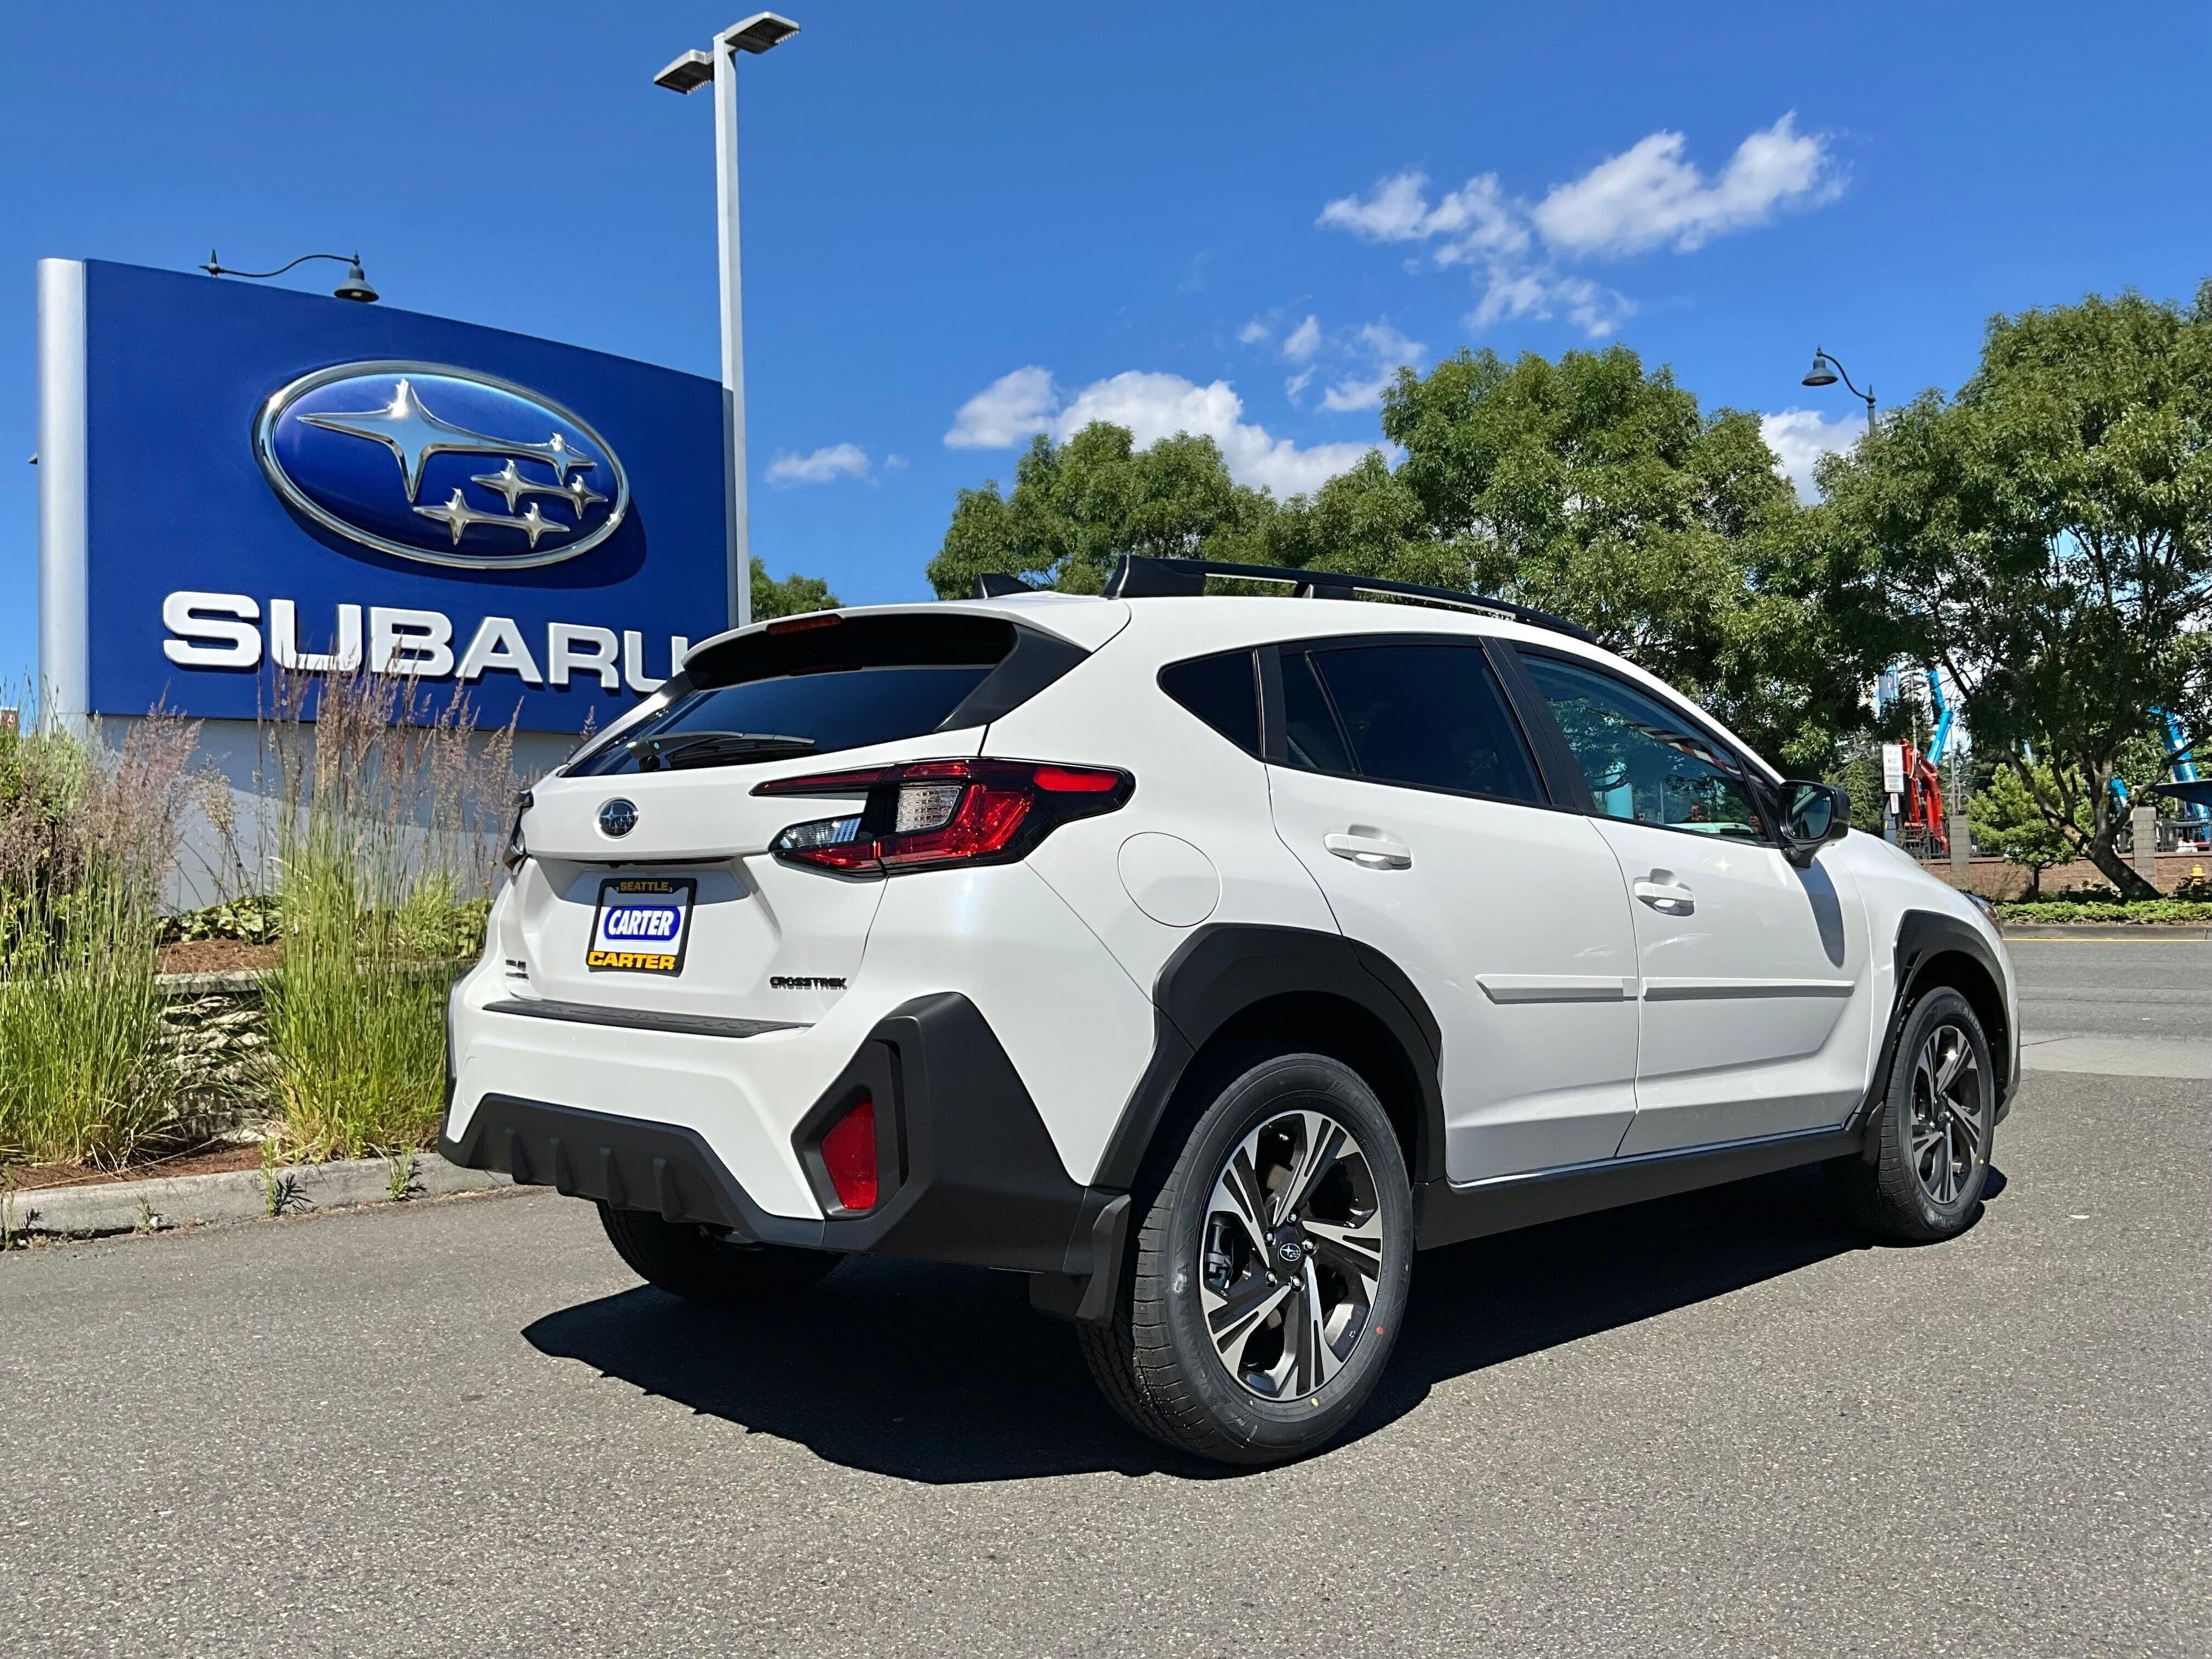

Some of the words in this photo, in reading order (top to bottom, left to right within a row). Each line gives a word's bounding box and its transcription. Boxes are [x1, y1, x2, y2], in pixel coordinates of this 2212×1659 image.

[163, 591, 688, 692] SUBARU
[620, 882, 669, 891] SEATTLE
[608, 910, 674, 936] CARTER
[588, 951, 676, 970] CARTER
[770, 977, 847, 988] CROSSTREK
